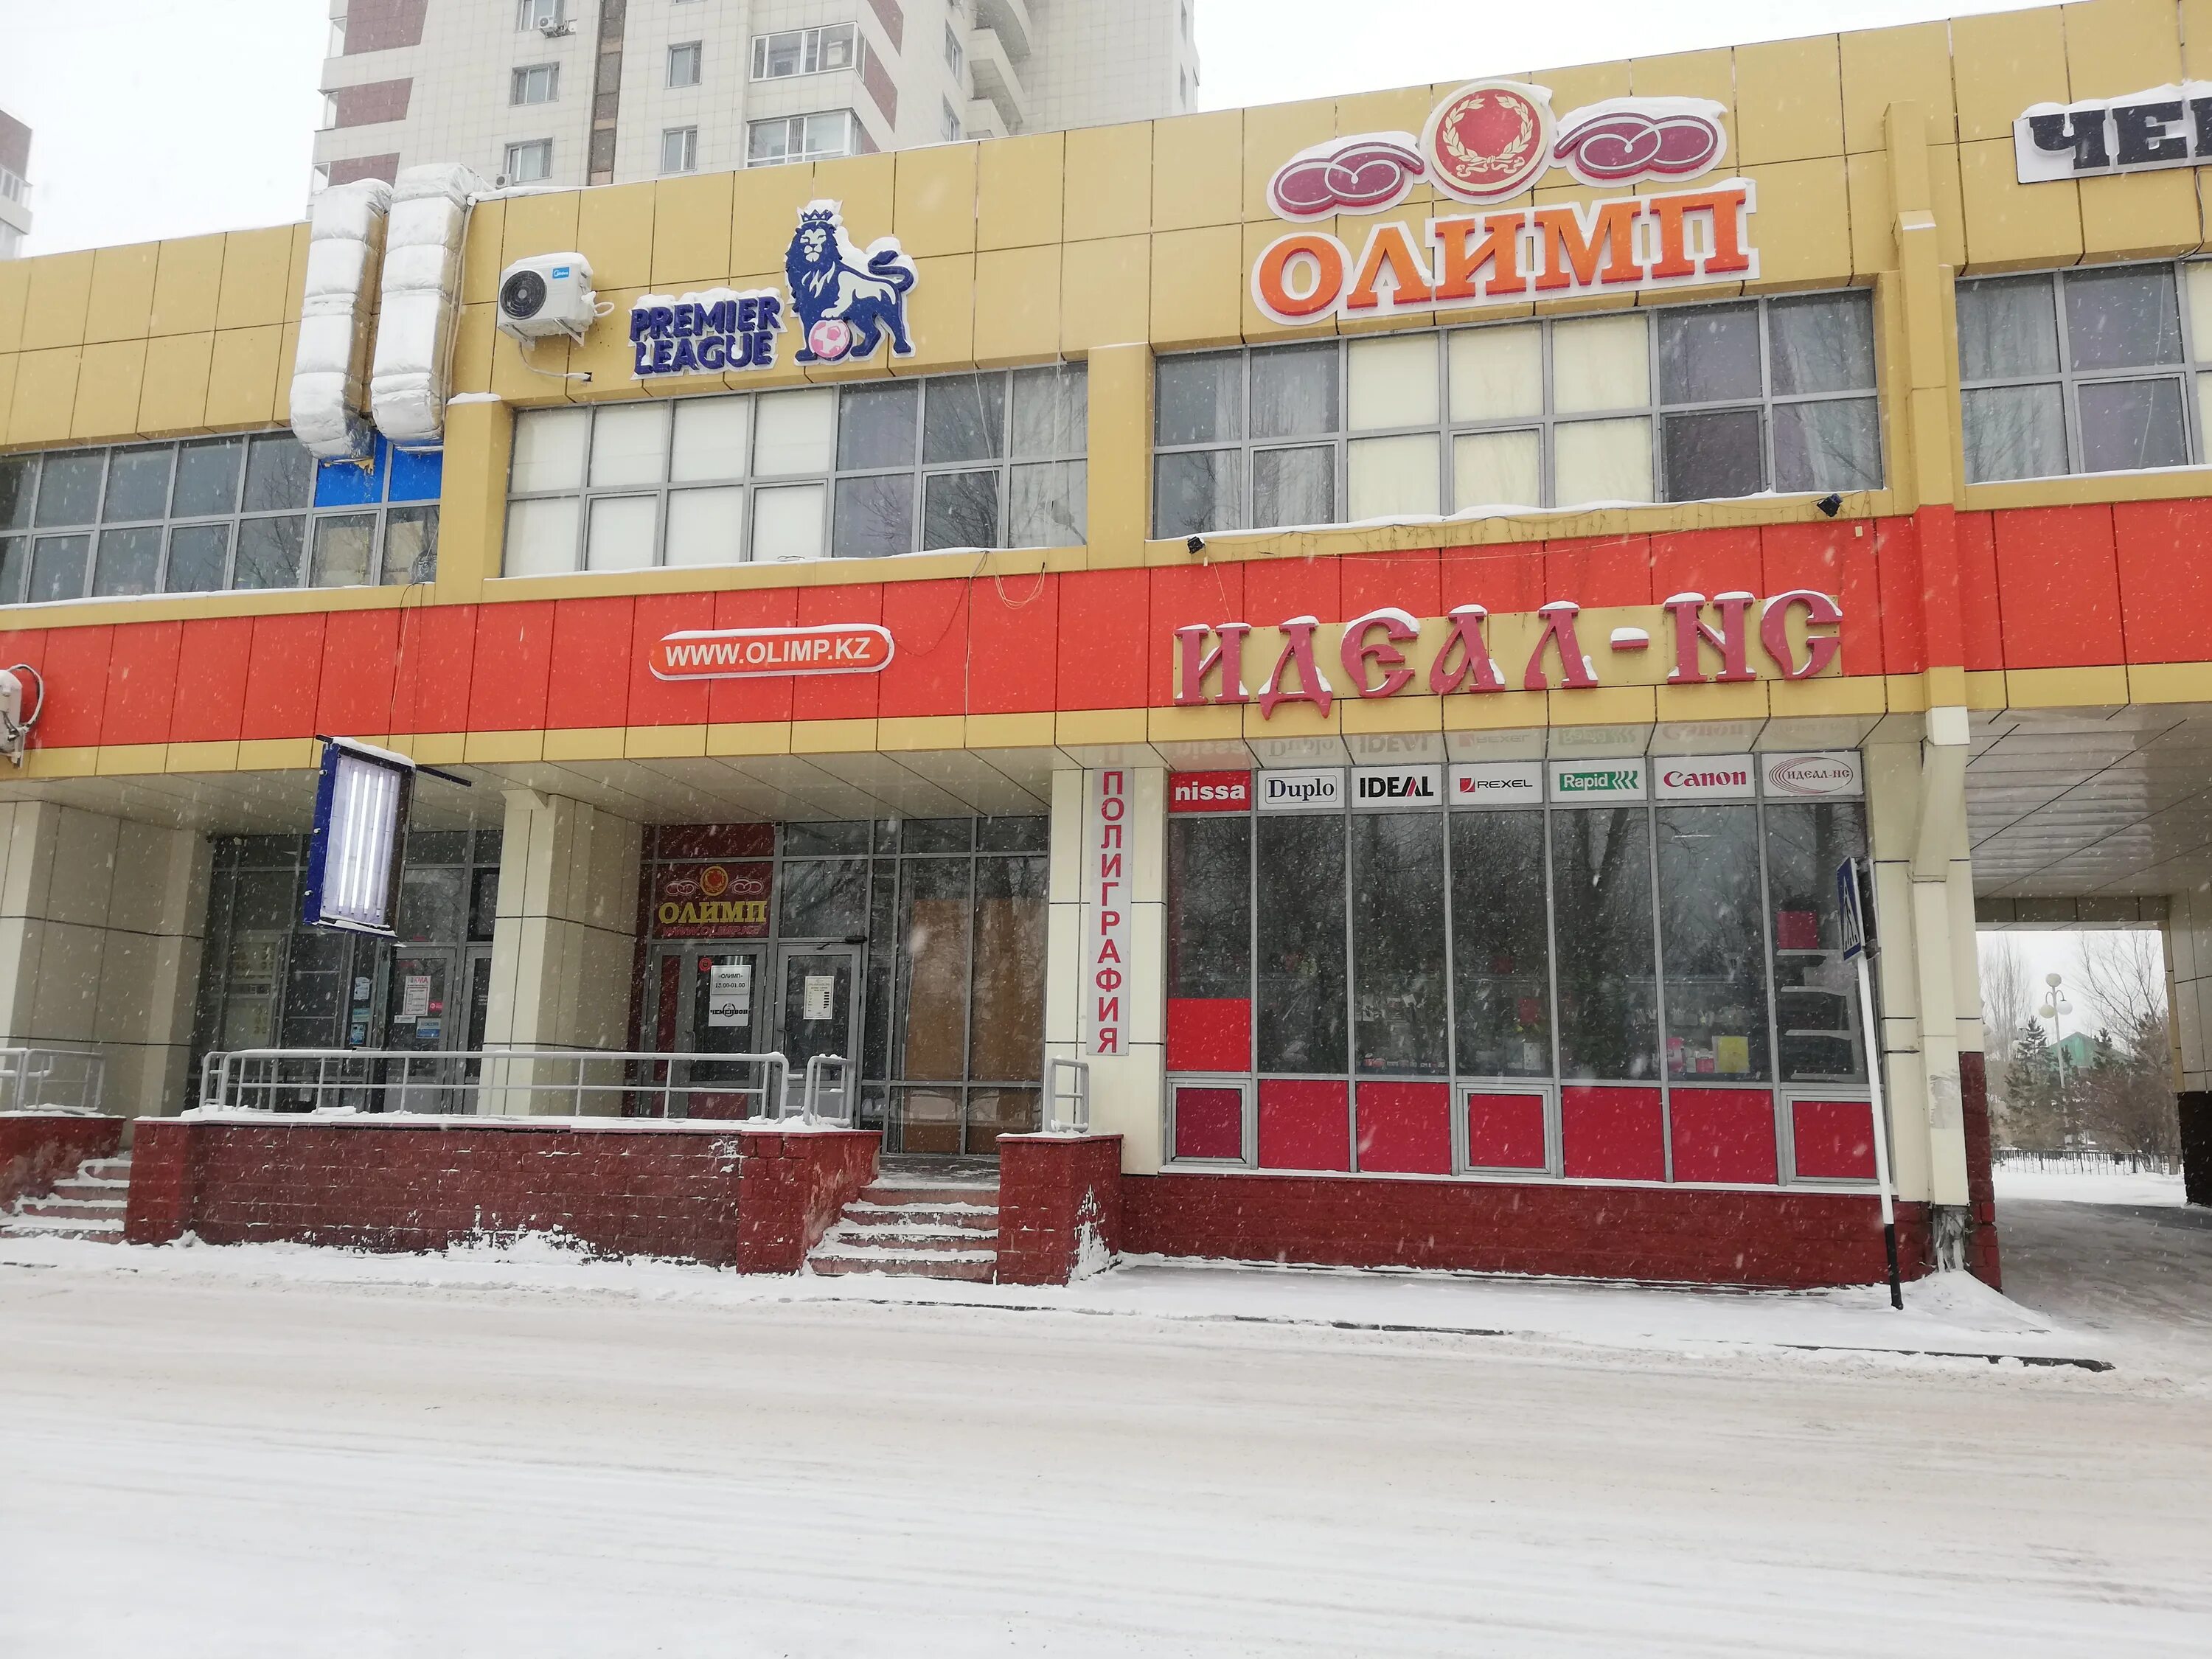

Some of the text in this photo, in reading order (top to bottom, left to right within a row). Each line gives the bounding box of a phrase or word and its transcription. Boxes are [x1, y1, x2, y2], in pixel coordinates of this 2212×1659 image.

[1258, 188, 1750, 316] ОЛИМП
[630, 296, 781, 344] PREMIER
[635, 330, 773, 375] LEAGUE
[665, 636, 872, 668] WWW.OLIMP.KZ
[1267, 778, 1335, 802] Duplo
[1360, 776, 1434, 799] IDEAL
[1477, 779, 1534, 789] REXEL
[1563, 773, 1609, 793] Rapid
[1663, 770, 1747, 787] Canon
[1175, 781, 1246, 801] nissa
[658, 900, 768, 924] ОЛИМП
[1095, 771, 1125, 1054] ПОЛИГРАФИЯ
